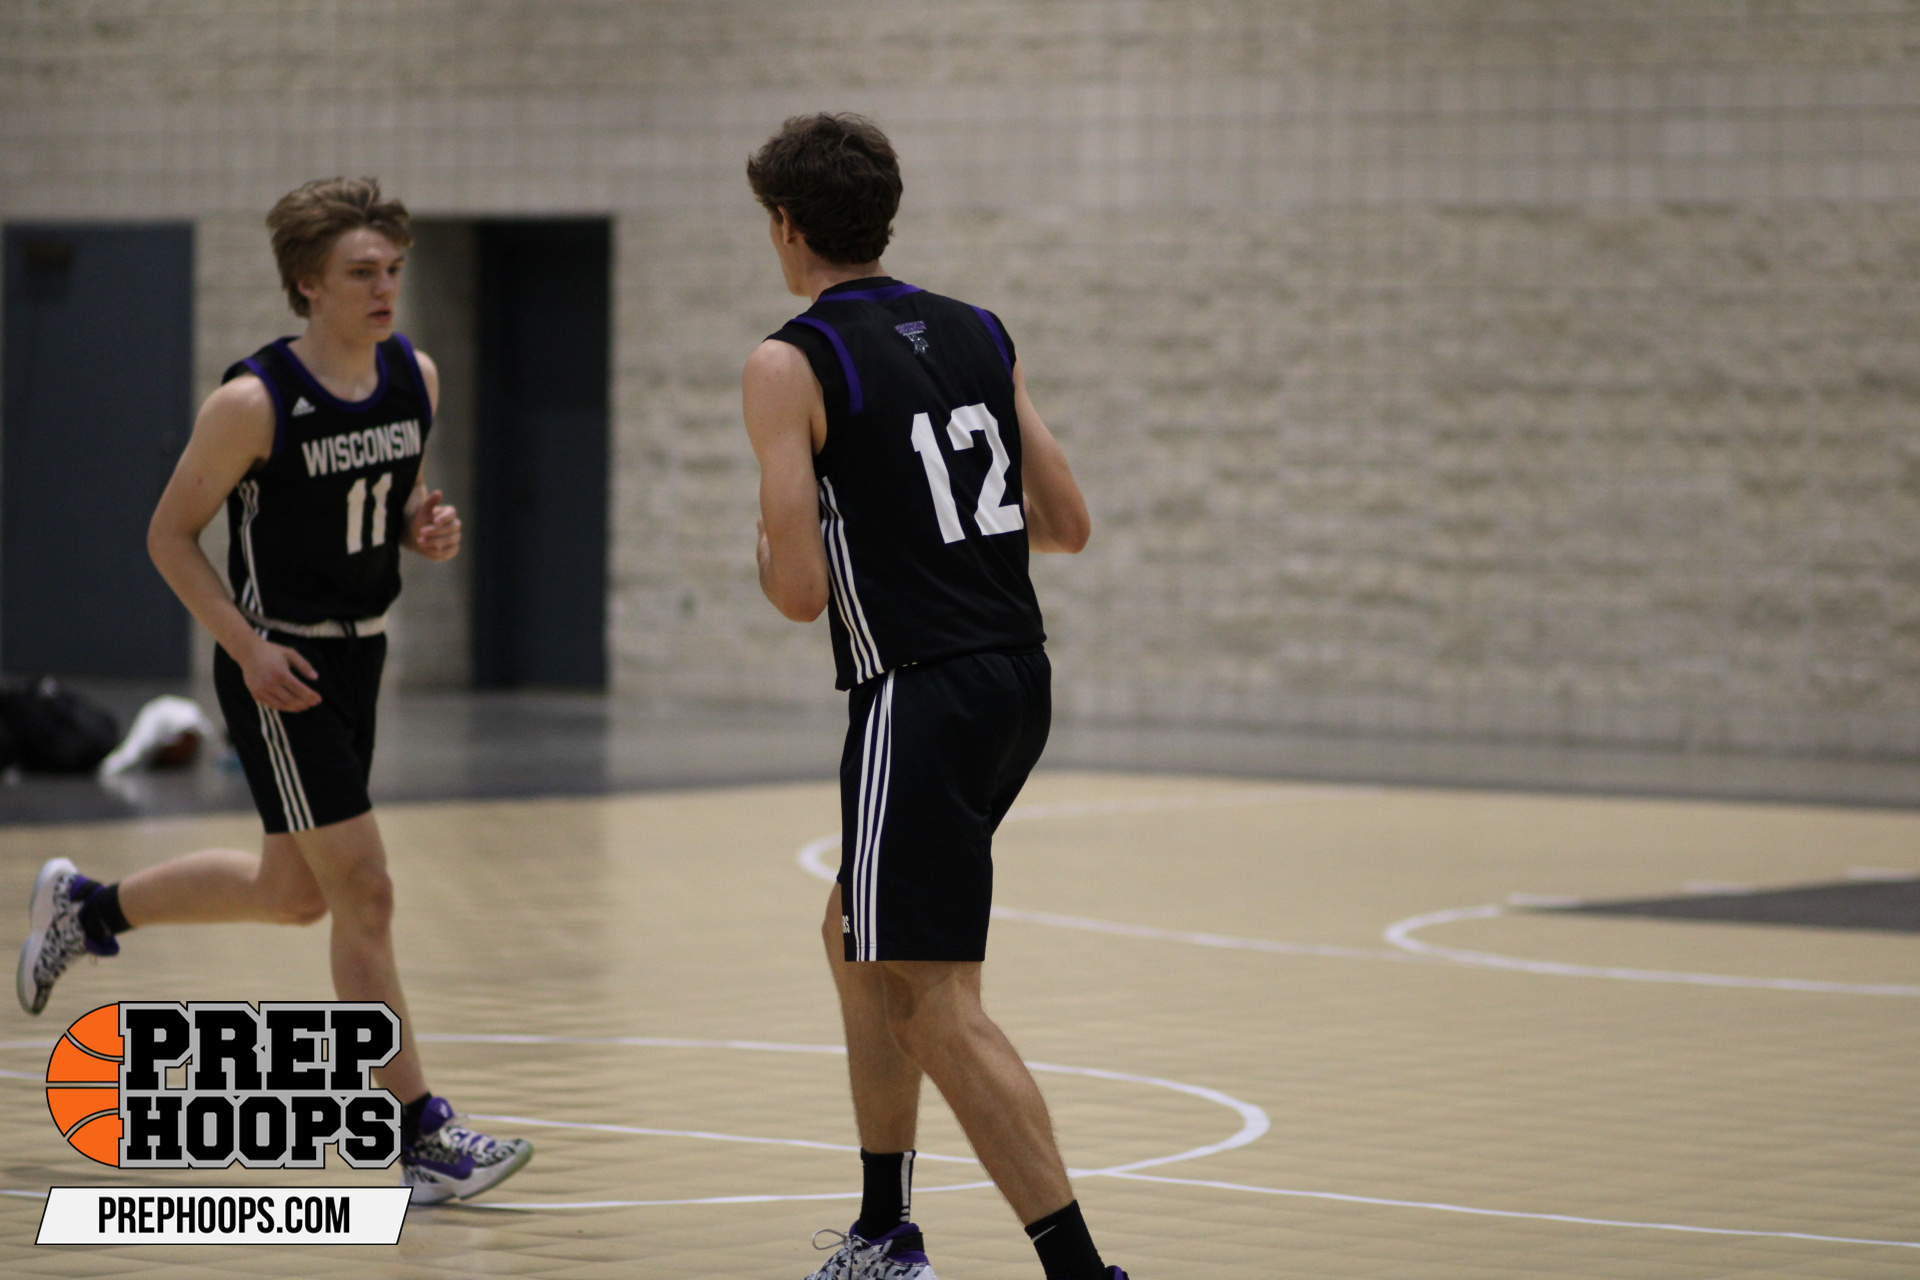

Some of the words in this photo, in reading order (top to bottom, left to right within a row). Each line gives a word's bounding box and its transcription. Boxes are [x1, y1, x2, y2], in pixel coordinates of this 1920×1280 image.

[302, 419, 421, 477] WISCONSIN
[911, 403, 1024, 544] 12
[347, 472, 392, 554] 11
